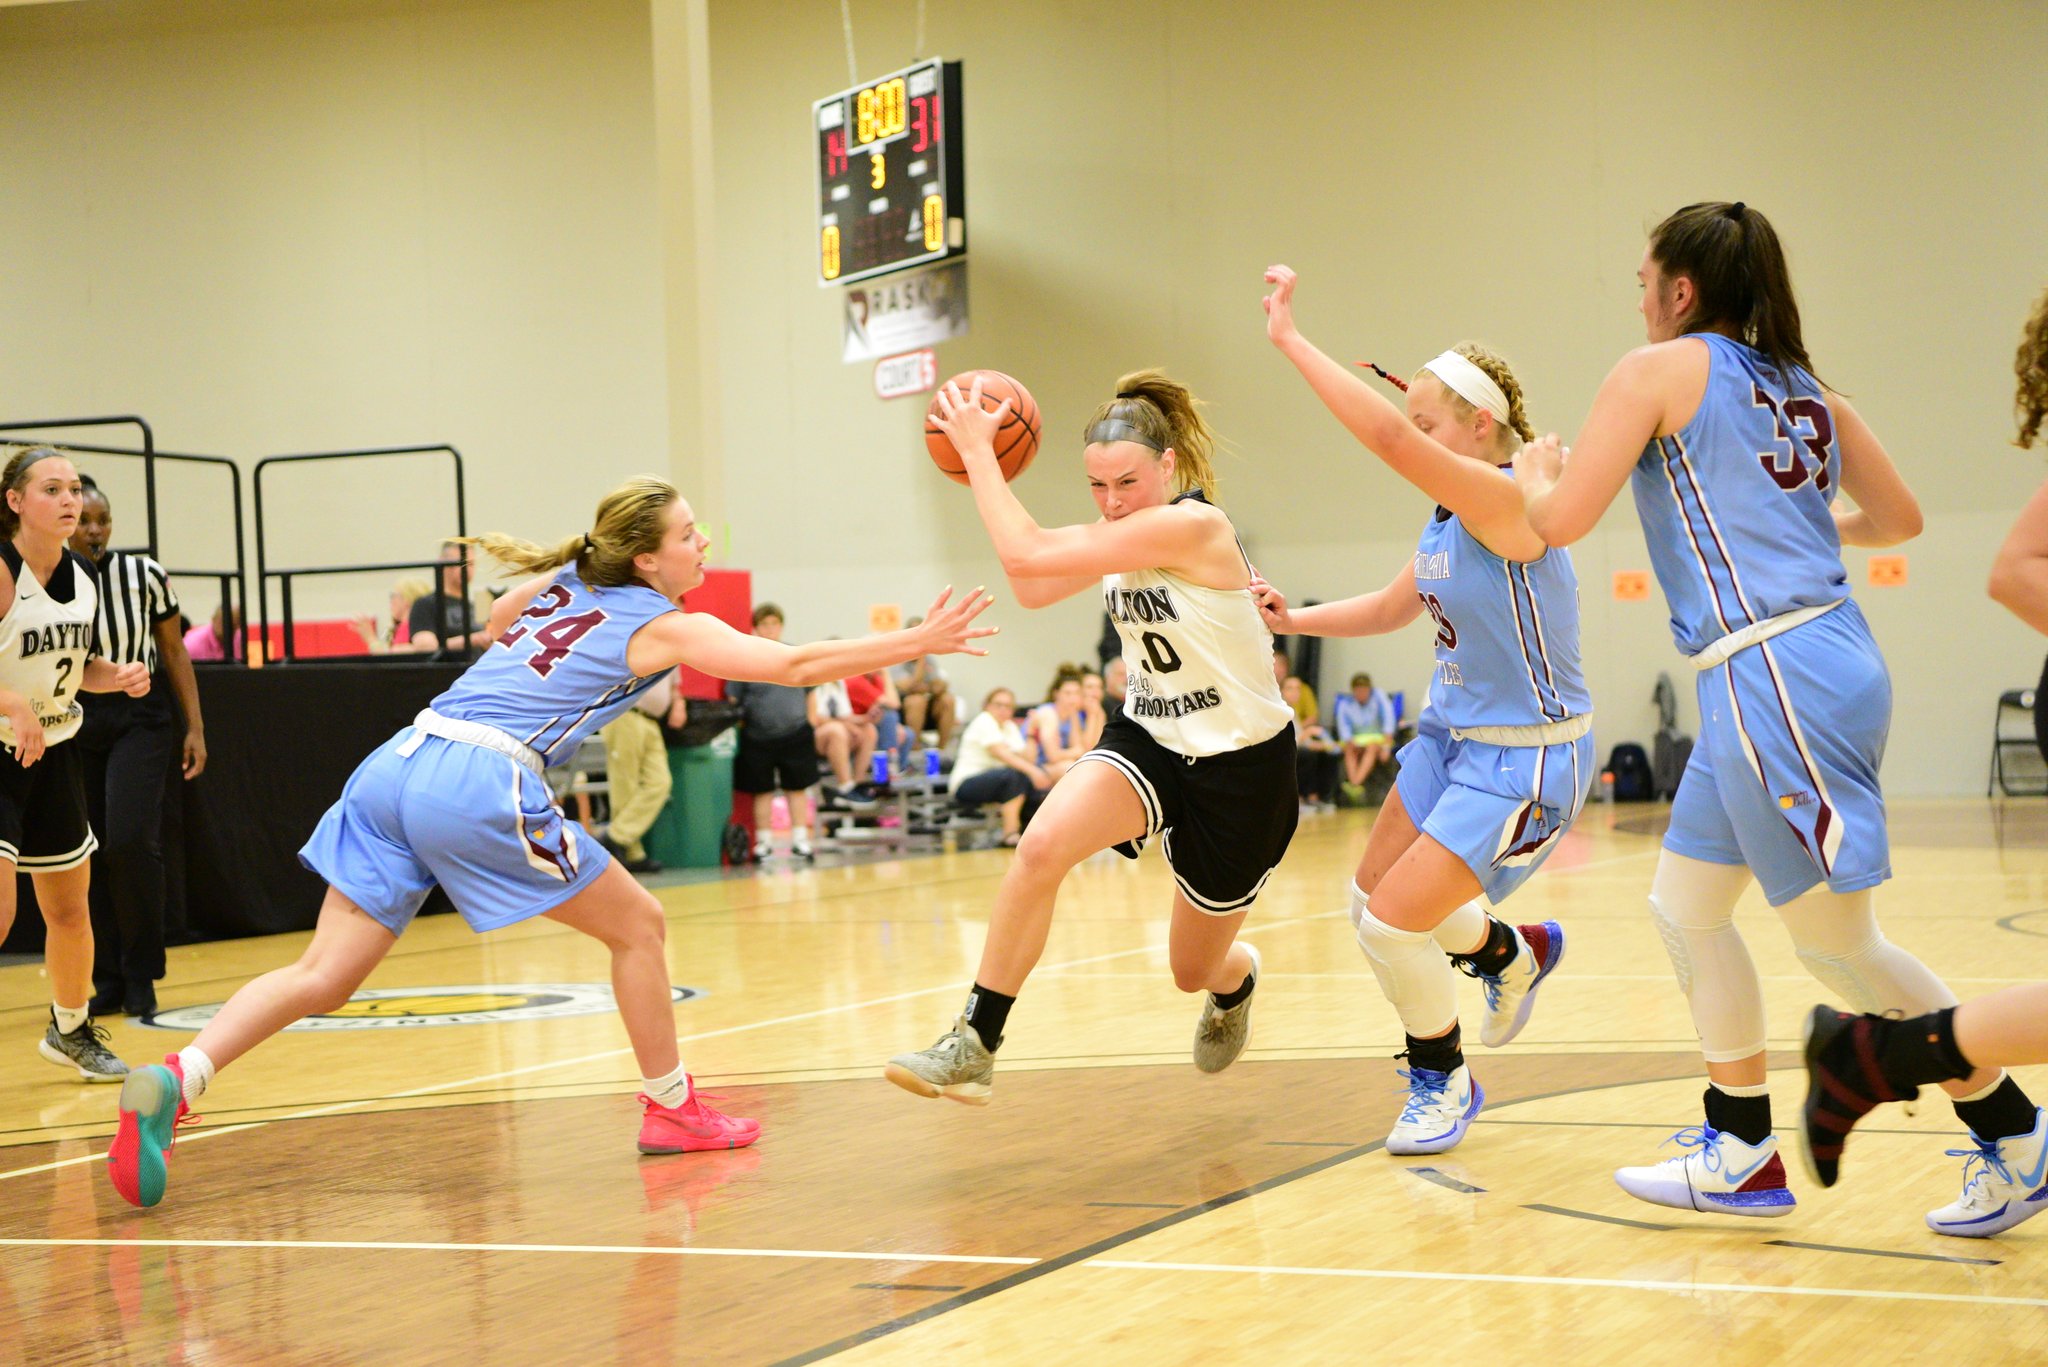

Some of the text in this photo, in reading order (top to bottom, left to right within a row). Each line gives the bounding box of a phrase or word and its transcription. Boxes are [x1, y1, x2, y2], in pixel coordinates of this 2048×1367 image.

[911, 95, 941, 152] 31
[871, 153, 886, 190] 3
[924, 194, 944, 251] 0
[822, 225, 840, 280] 0
[1750, 380, 1834, 493] 33
[494, 583, 611, 681] 24
[53, 657, 73, 697] 2
